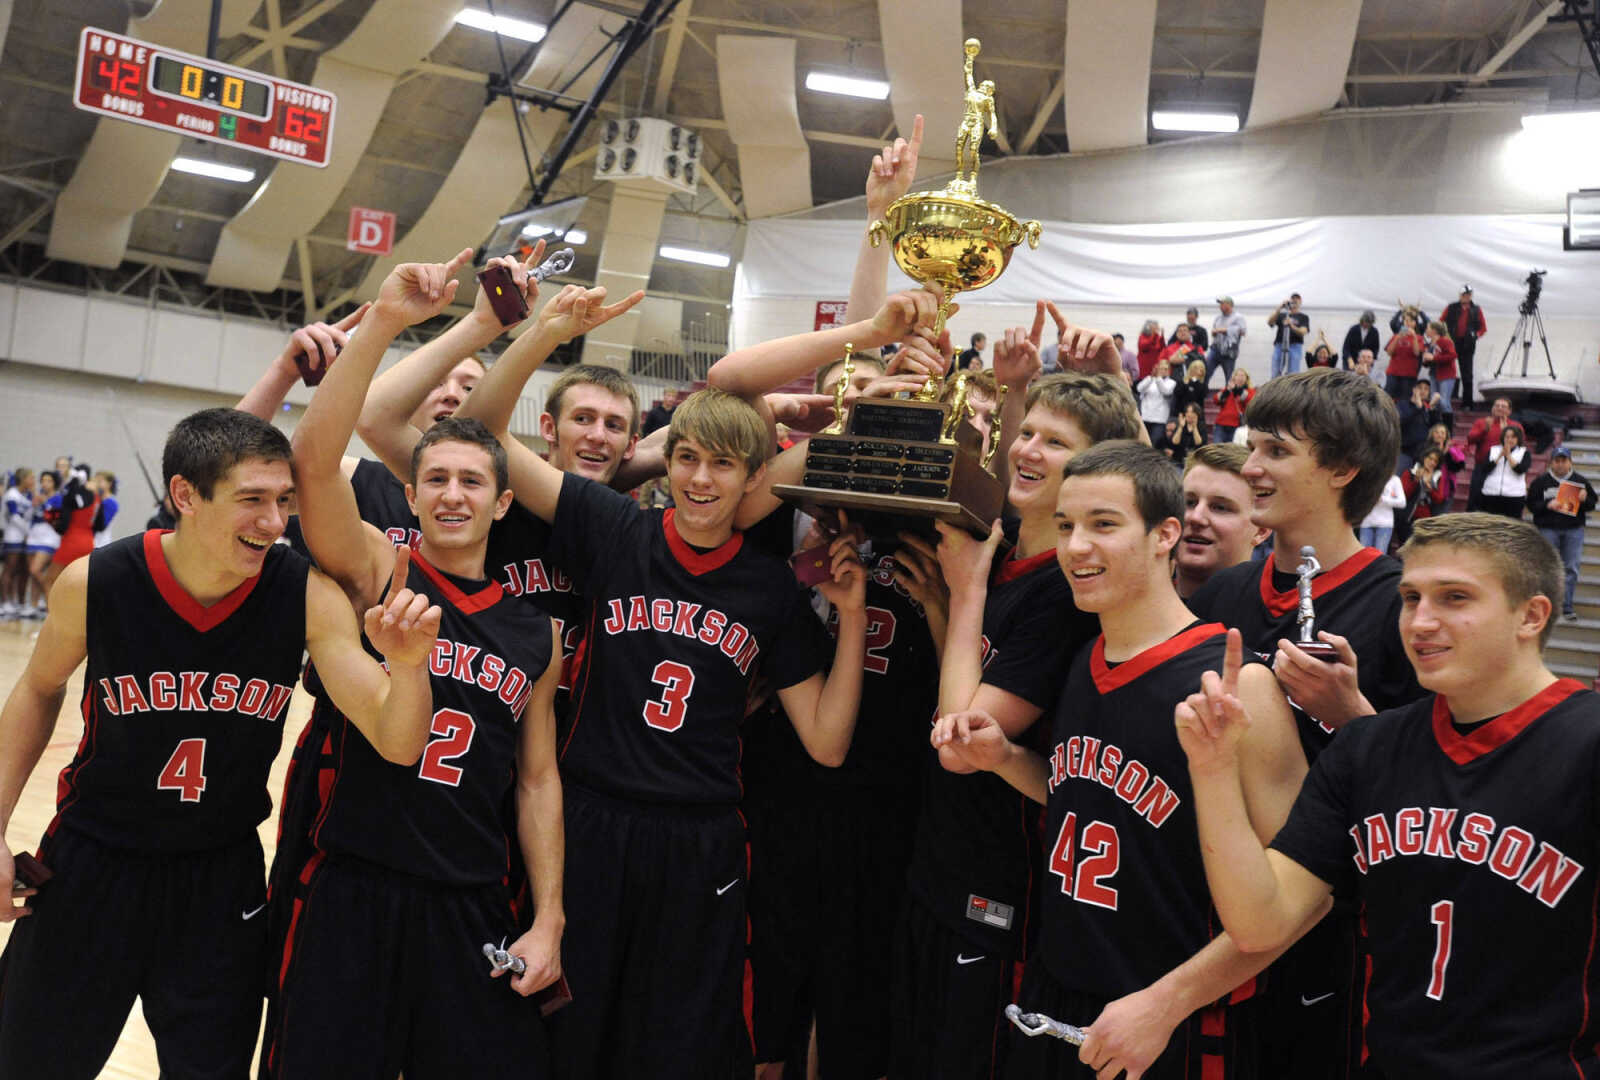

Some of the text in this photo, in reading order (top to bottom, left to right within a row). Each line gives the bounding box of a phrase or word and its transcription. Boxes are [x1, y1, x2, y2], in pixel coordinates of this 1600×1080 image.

[90, 35, 147, 64] HOME
[99, 61, 141, 96] 42
[277, 85, 330, 112] VISITOR
[102, 93, 144, 116] BONUS
[176, 113, 215, 133] PERIOD
[285, 106, 323, 143] 62
[220, 115, 237, 139] 4
[269, 135, 307, 156] BONUS
[359, 221, 383, 247] D
[604, 595, 760, 676] JACKSON
[100, 671, 293, 721] JACKSON
[643, 659, 696, 733] 3
[418, 707, 476, 787] 2
[157, 738, 207, 803] 4
[1048, 735, 1181, 829] JACKSON
[1049, 811, 1120, 912] 42
[1349, 806, 1584, 908] JACKSON
[1426, 899, 1454, 1001] 1
